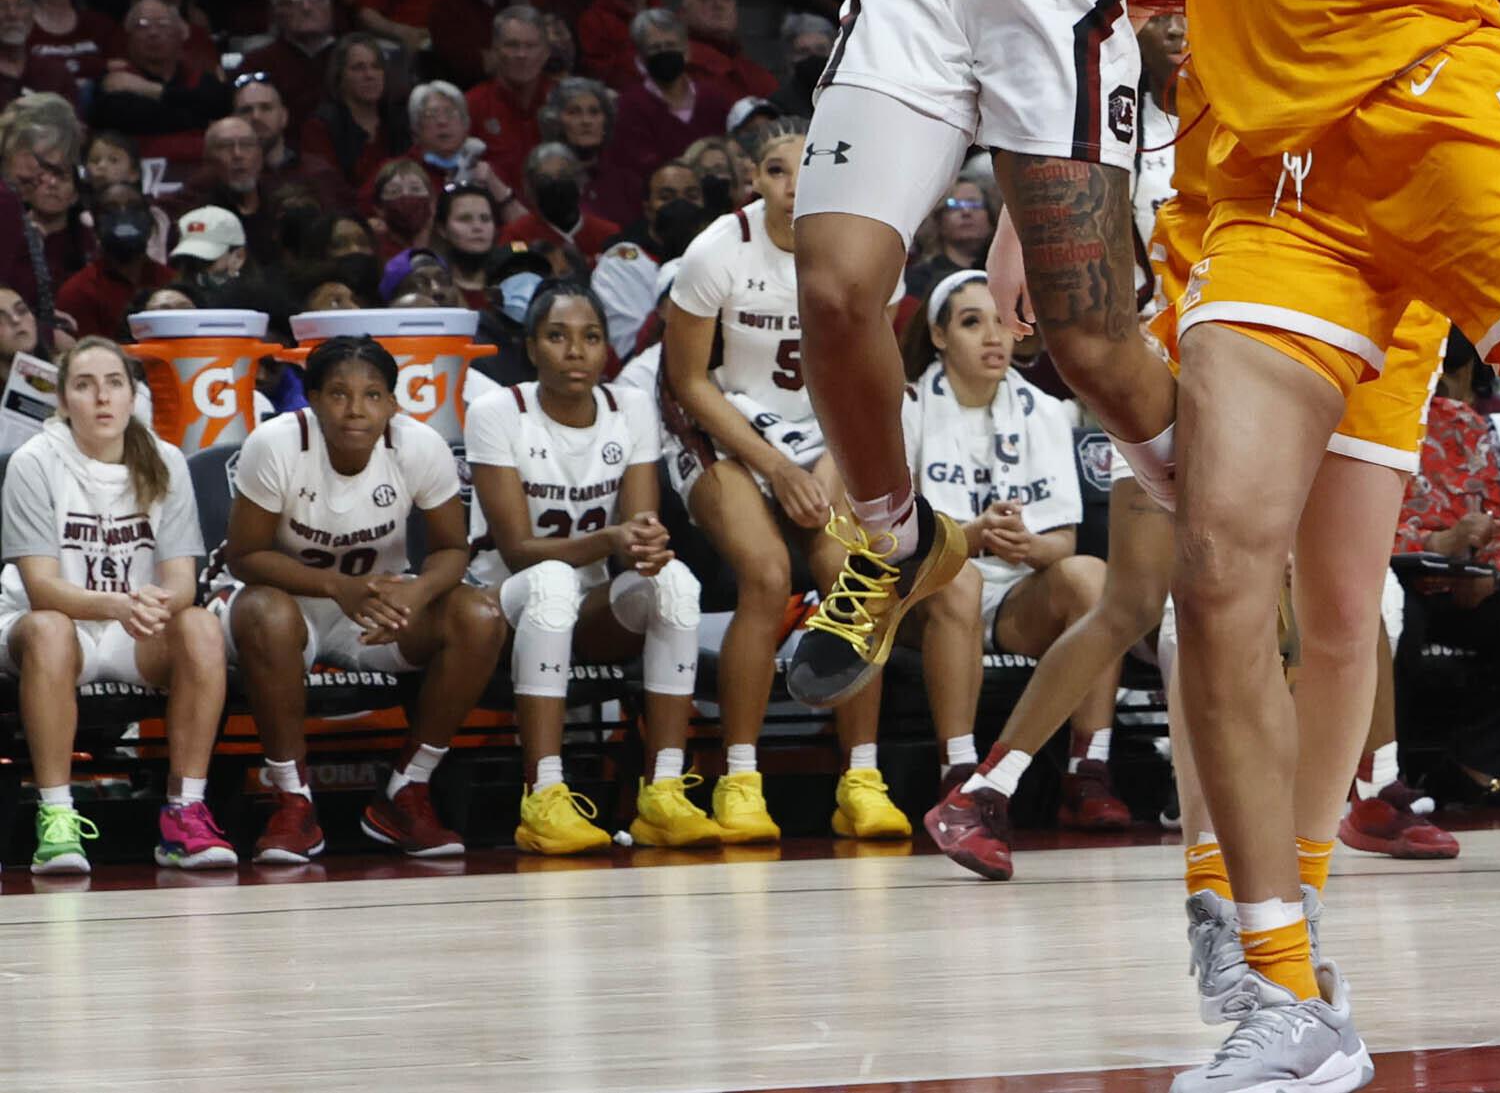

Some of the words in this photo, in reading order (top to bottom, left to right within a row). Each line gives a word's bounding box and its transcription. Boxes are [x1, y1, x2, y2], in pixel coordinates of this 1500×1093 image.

[395, 364, 437, 414] G
[772, 339, 805, 391] 5
[192, 367, 236, 418] G
